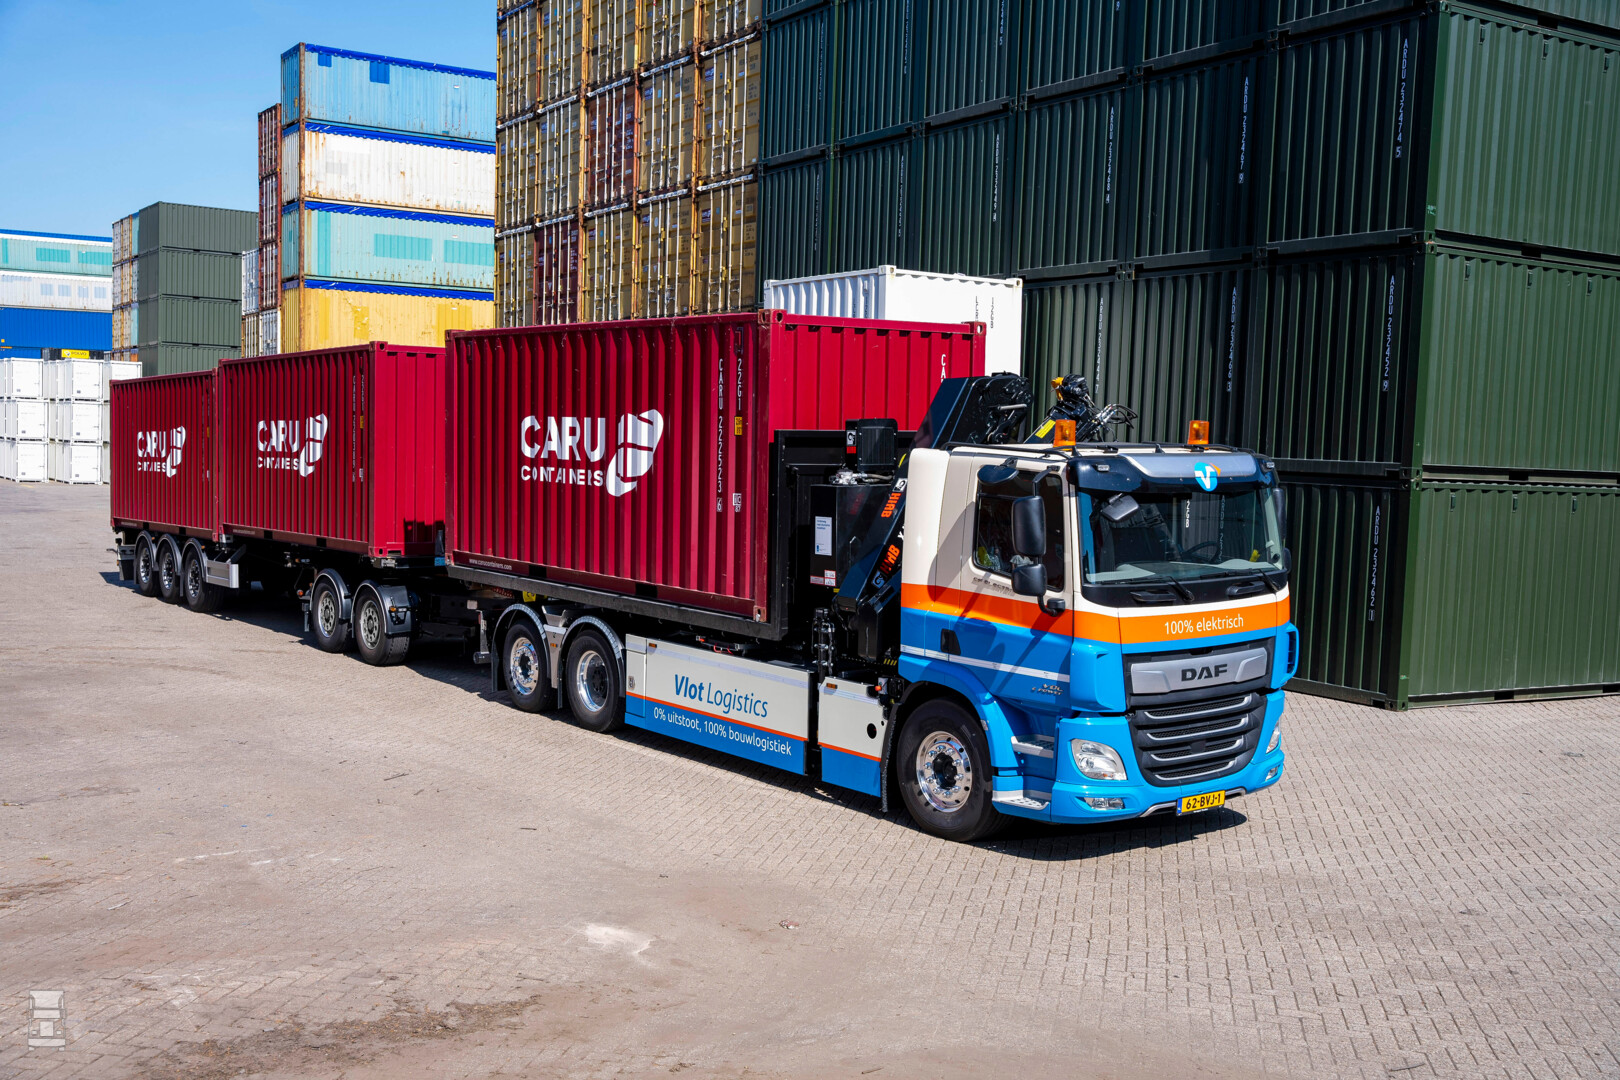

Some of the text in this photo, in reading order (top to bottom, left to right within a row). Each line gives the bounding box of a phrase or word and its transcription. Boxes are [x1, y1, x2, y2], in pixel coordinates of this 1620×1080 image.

[1397, 82, 1405, 142] 232474
[1395, 146, 1402, 158] 5
[1238, 173, 1244, 184] 9
[1382, 275, 1396, 392] ARDU 232452 9
[1226, 380, 1232, 392] 3
[137, 431, 166, 458] CARU
[257, 420, 300, 453] CARU
[521, 415, 606, 462] CARU
[521, 465, 604, 487] CONTAINERS
[716, 497, 722, 512] 6
[881, 492, 901, 518] HIAB
[1368, 505, 1381, 621] ARDU 232462 1
[1164, 613, 1244, 635] 100% elektrisch
[1181, 663, 1228, 682] DAF
[674, 673, 769, 718] Vlot Logistics
[653, 707, 792, 757] 0% uitstoot, 100% bouwlogistiek
[1186, 793, 1221, 810] 62-BVJ-1
